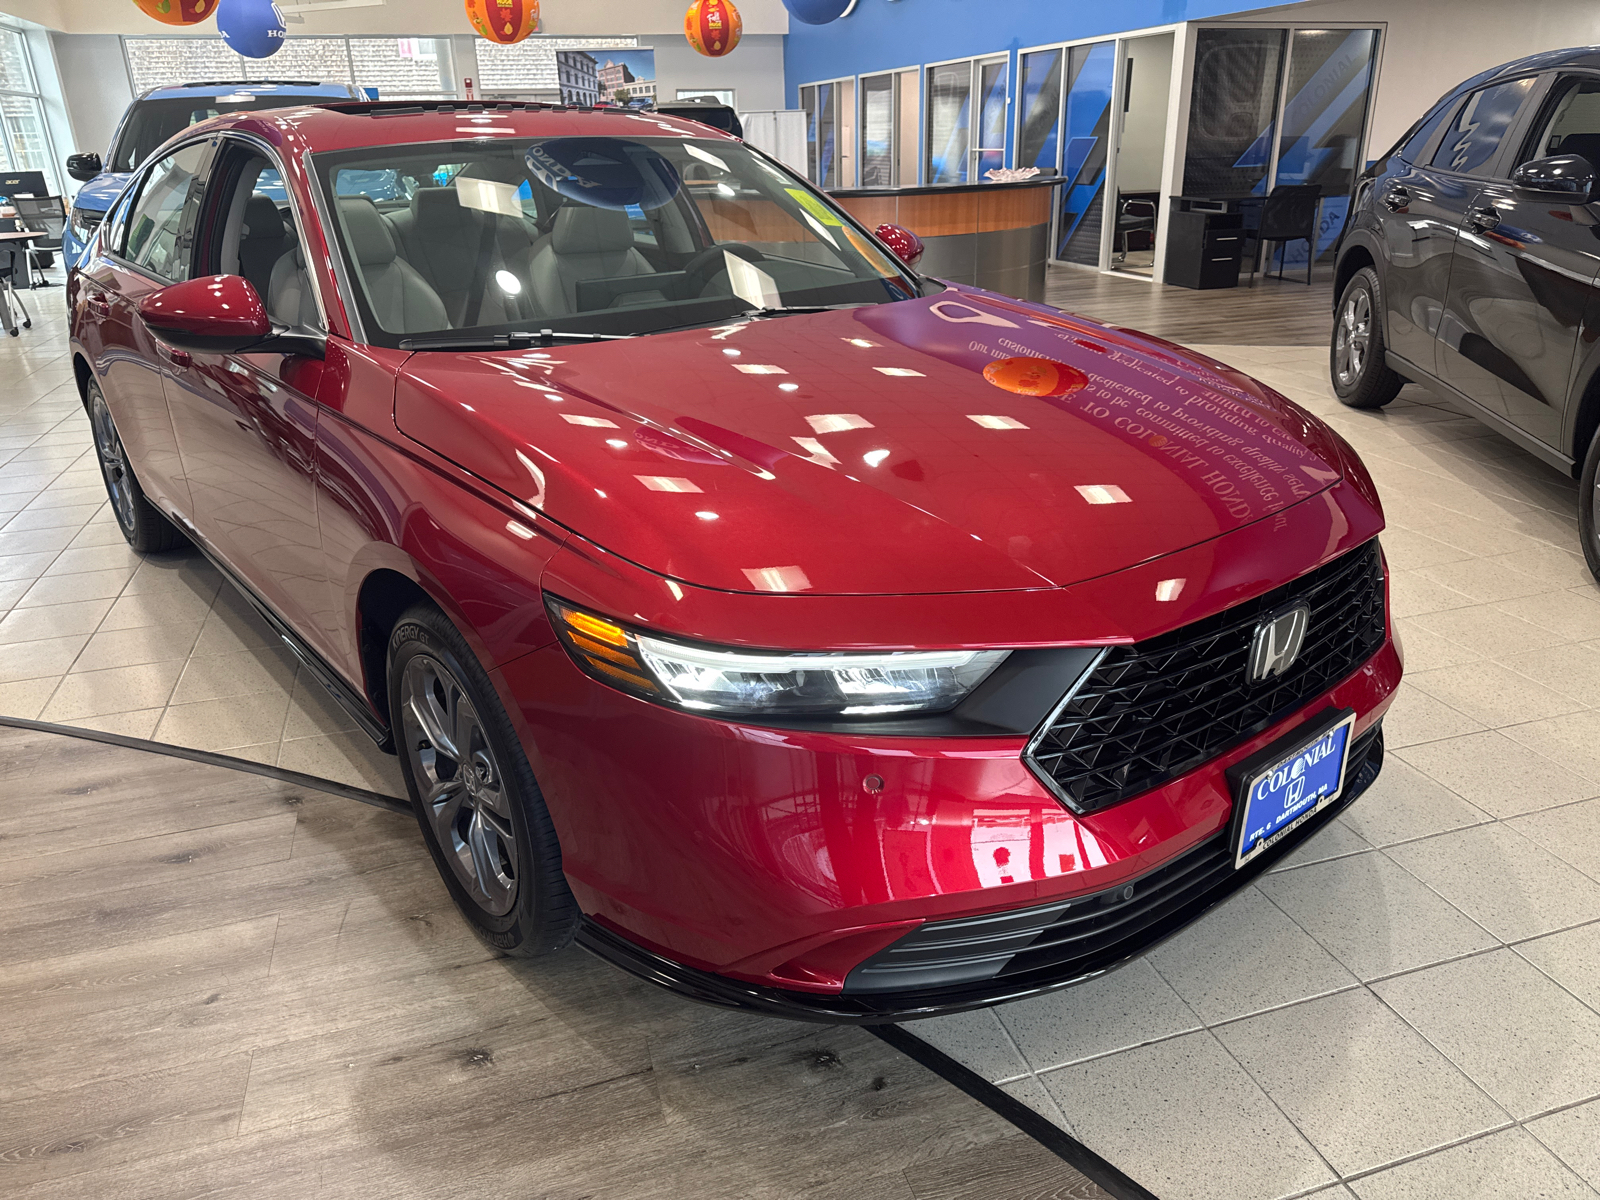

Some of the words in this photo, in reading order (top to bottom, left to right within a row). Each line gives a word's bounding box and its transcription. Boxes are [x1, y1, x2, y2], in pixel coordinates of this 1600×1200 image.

[420, 632, 429, 645] GT
[1257, 738, 1336, 800] COLONIAL
[1262, 823, 1294, 850] COLONIAL
[1295, 806, 1317, 827] HONDA
[1266, 821, 1272, 831] 6
